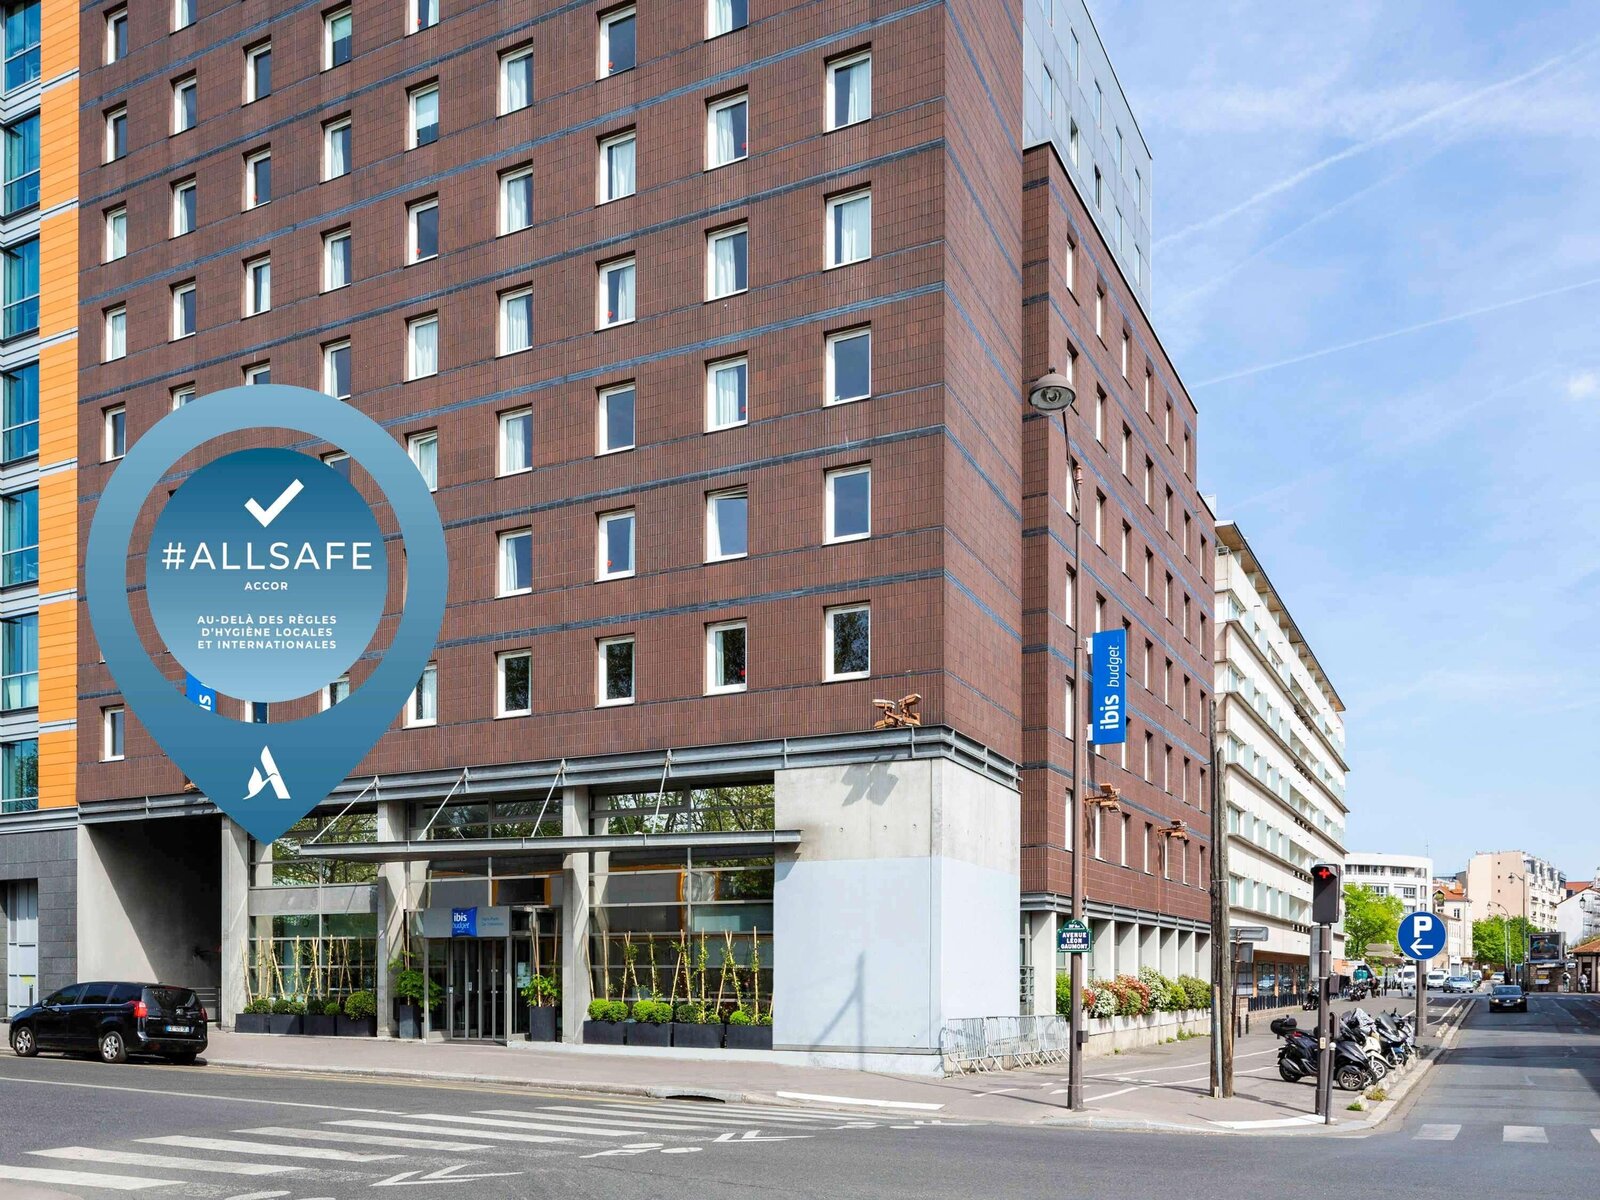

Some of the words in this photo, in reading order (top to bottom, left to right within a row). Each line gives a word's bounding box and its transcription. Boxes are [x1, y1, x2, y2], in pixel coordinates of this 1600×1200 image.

[1106, 645, 1122, 687] budget
[1100, 694, 1120, 730] ibis
[453, 912, 468, 922] ibis
[1413, 916, 1433, 938] P
